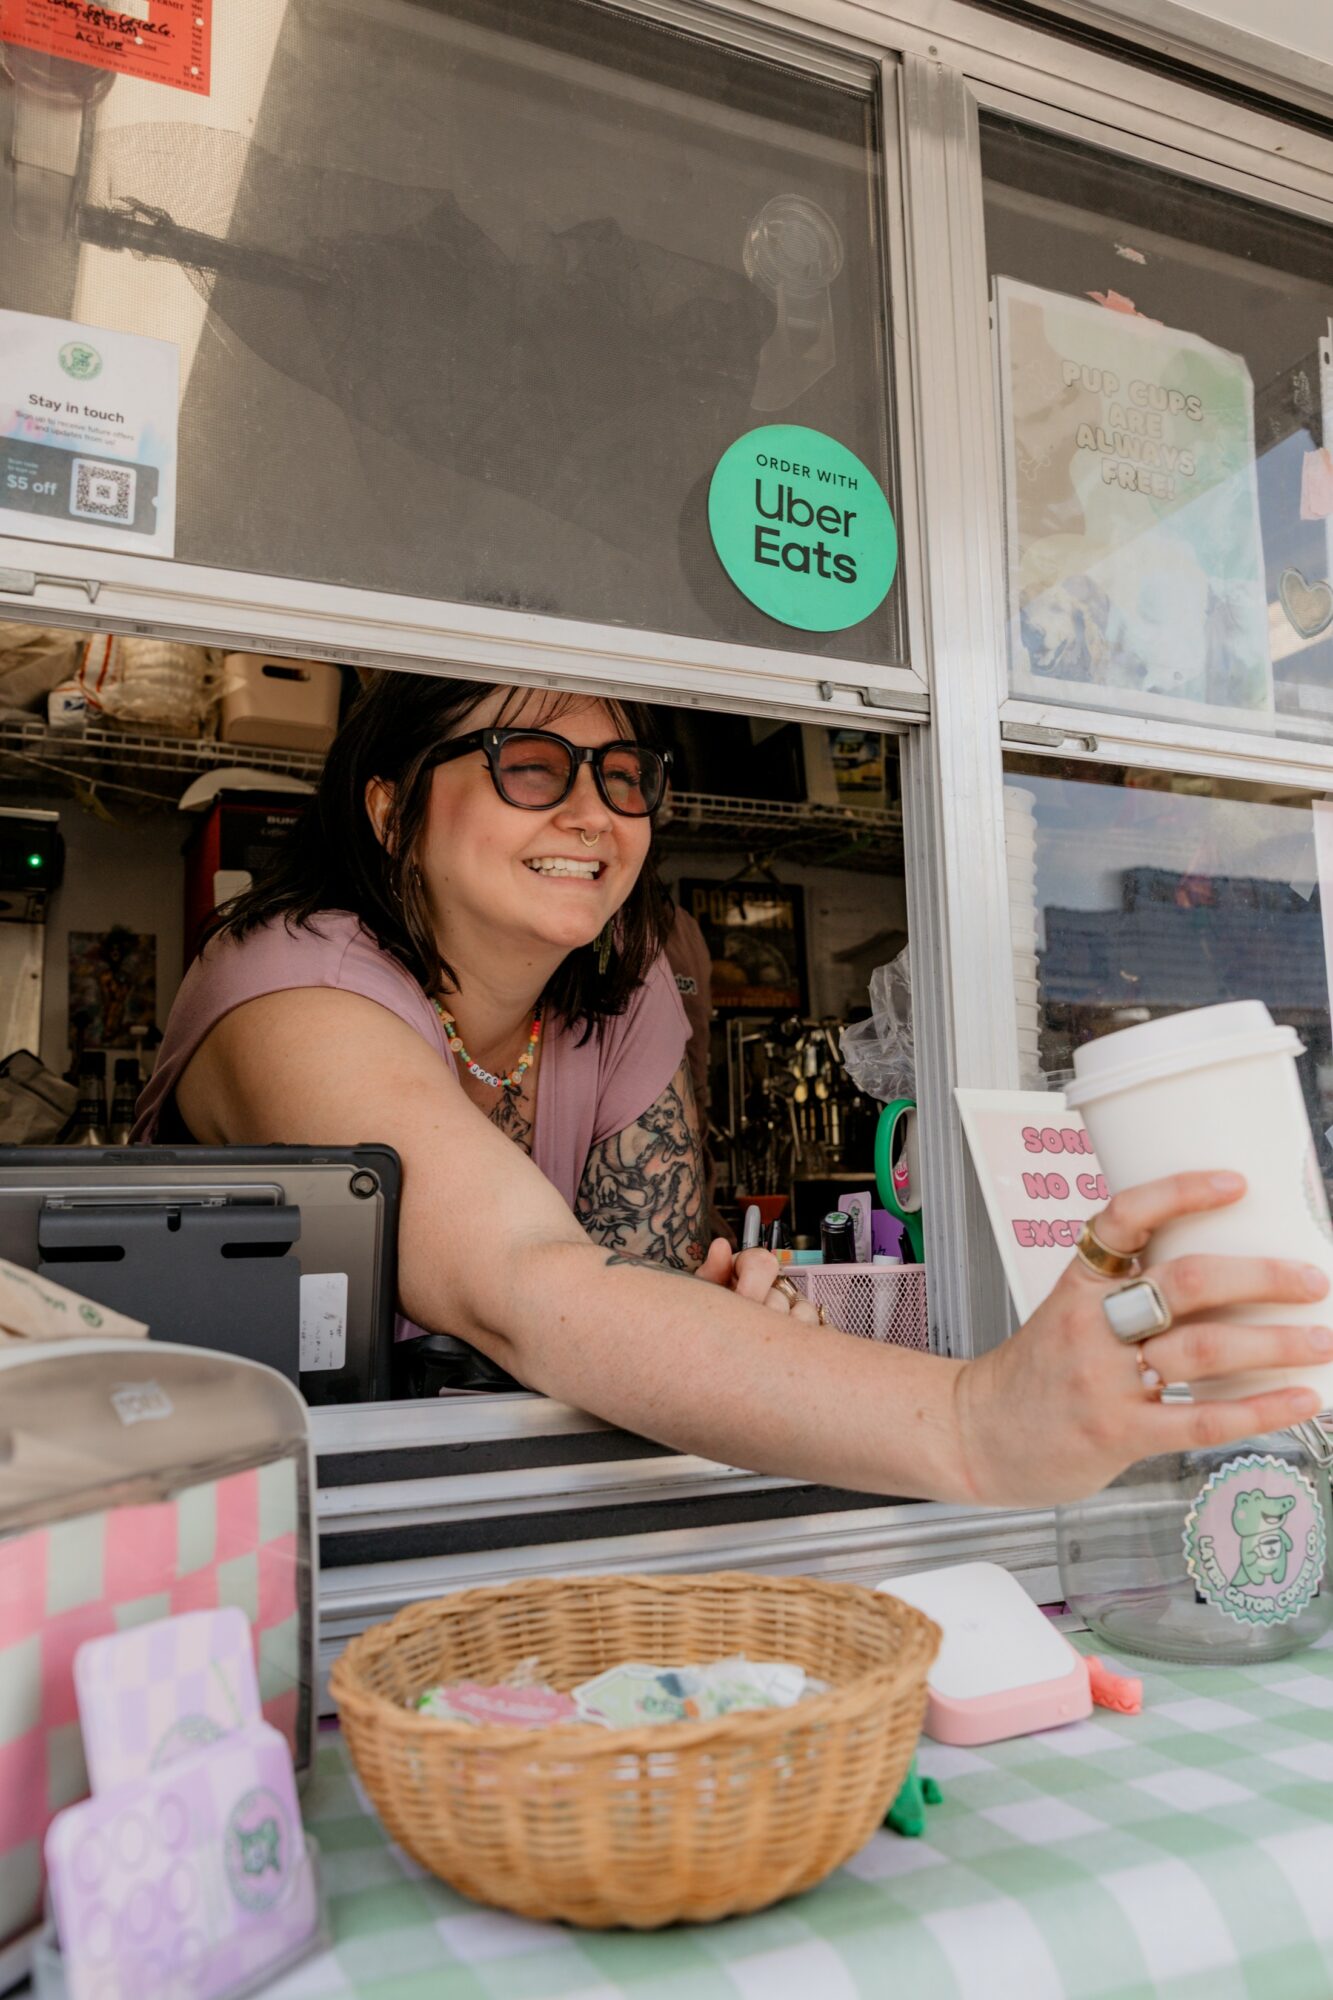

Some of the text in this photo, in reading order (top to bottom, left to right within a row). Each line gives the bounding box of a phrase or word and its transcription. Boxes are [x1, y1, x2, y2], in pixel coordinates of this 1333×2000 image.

[28, 394, 125, 424] Stay in touch
[1061, 360, 1204, 422] PUP CUPS
[1108, 402, 1164, 439] ARE
[1075, 422, 1197, 478] ALWAYS
[7, 473, 58, 496] $5 off
[756, 453, 858, 491] ORDER WITH
[1102, 458, 1176, 501] FREE!
[755, 478, 857, 538] Uber
[754, 524, 858, 584] Eats
[1021, 1172, 1070, 1200] NO
[1224, 1585, 1275, 1614] GATOR
